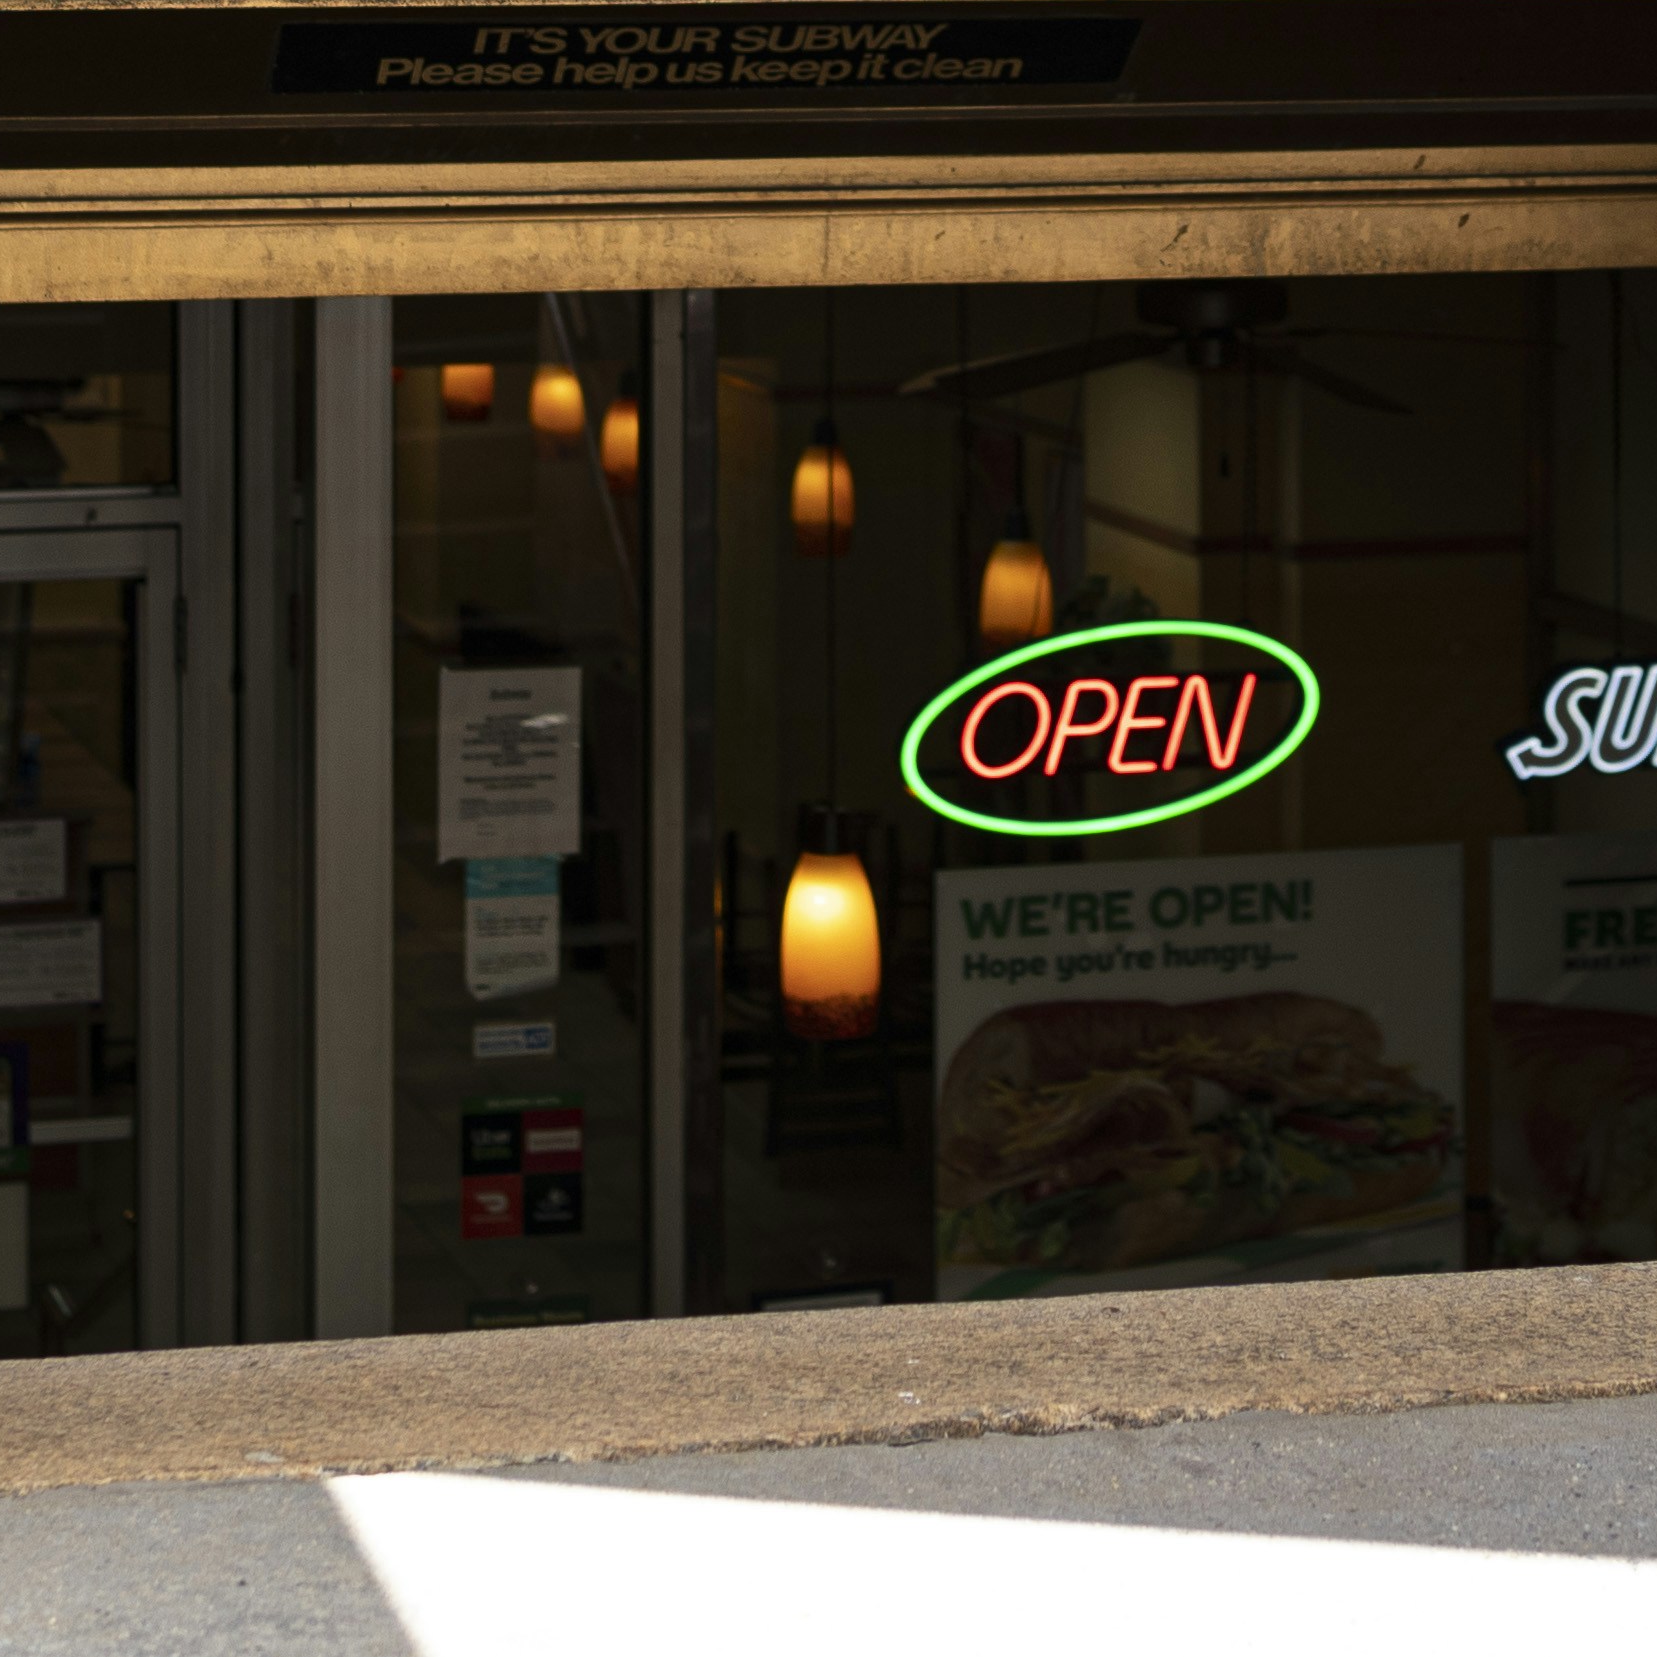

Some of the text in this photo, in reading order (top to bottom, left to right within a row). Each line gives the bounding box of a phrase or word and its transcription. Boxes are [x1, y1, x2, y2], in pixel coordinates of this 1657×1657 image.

[472, 22, 948, 54] IT'S YOUR SUBWAY
[376, 52, 1024, 90] Please help us keep it clean
[960, 672, 1258, 779] OPEN
[960, 880, 1315, 942] WE'RE OPEN!
[962, 953, 1047, 986] Hope
[1055, 943, 1155, 983] you're
